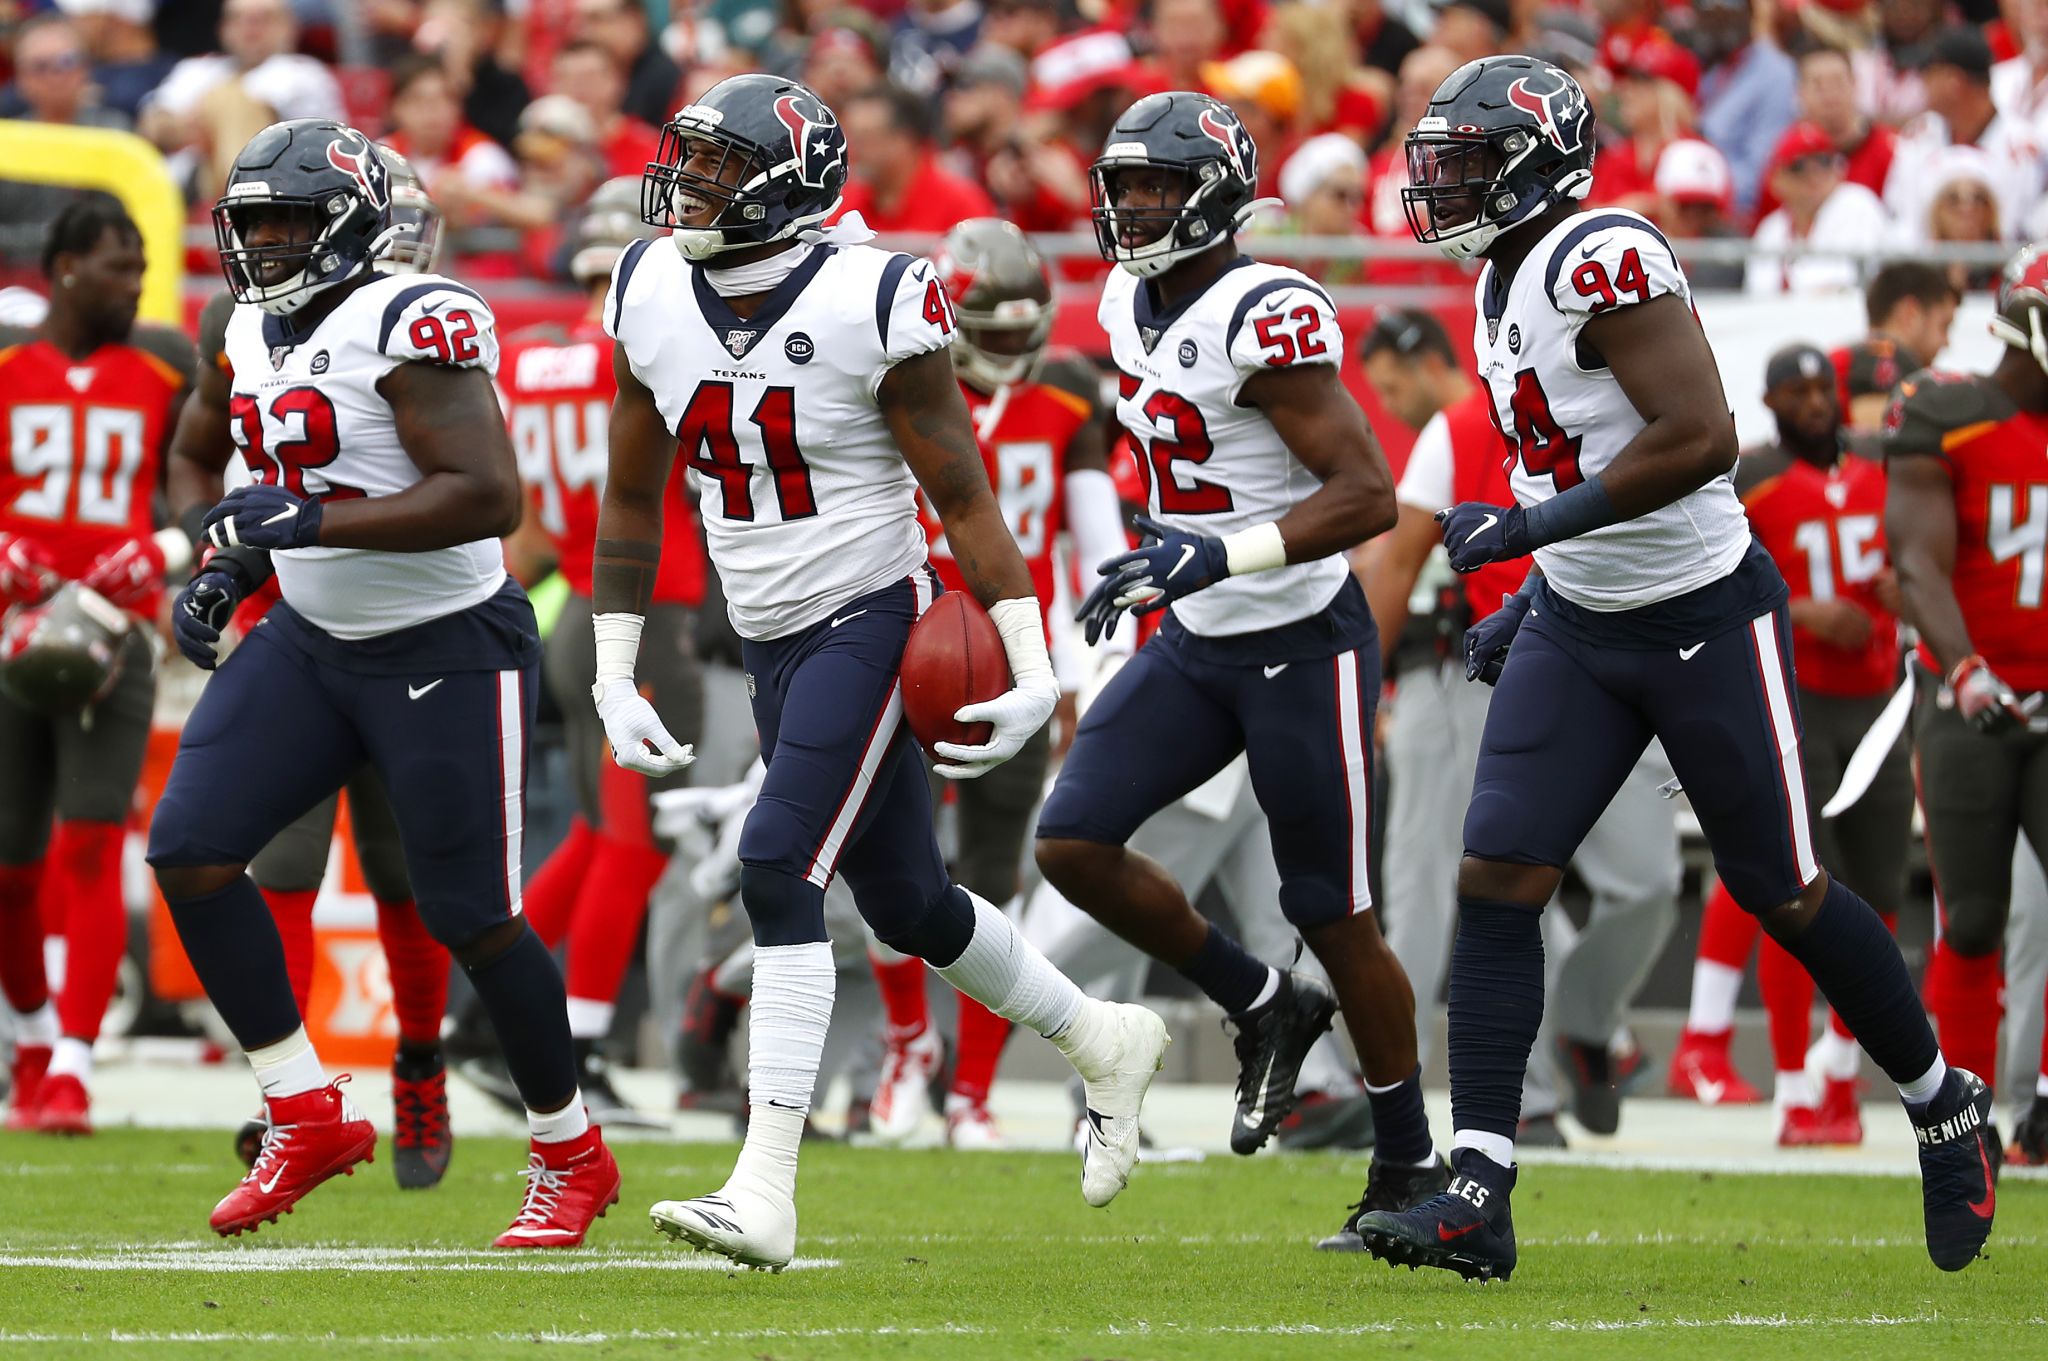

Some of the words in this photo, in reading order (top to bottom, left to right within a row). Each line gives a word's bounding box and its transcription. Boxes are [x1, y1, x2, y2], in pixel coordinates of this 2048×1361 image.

[1571, 247, 1649, 314] 94
[409, 310, 480, 364] 92
[1252, 304, 1328, 367] 52
[712, 369, 767, 380] TEXANS
[10, 403, 145, 527] 90
[511, 399, 609, 536] 94
[676, 380, 818, 522] 41
[1795, 515, 1885, 604] 15
[1446, 1176, 1490, 1208] LES
